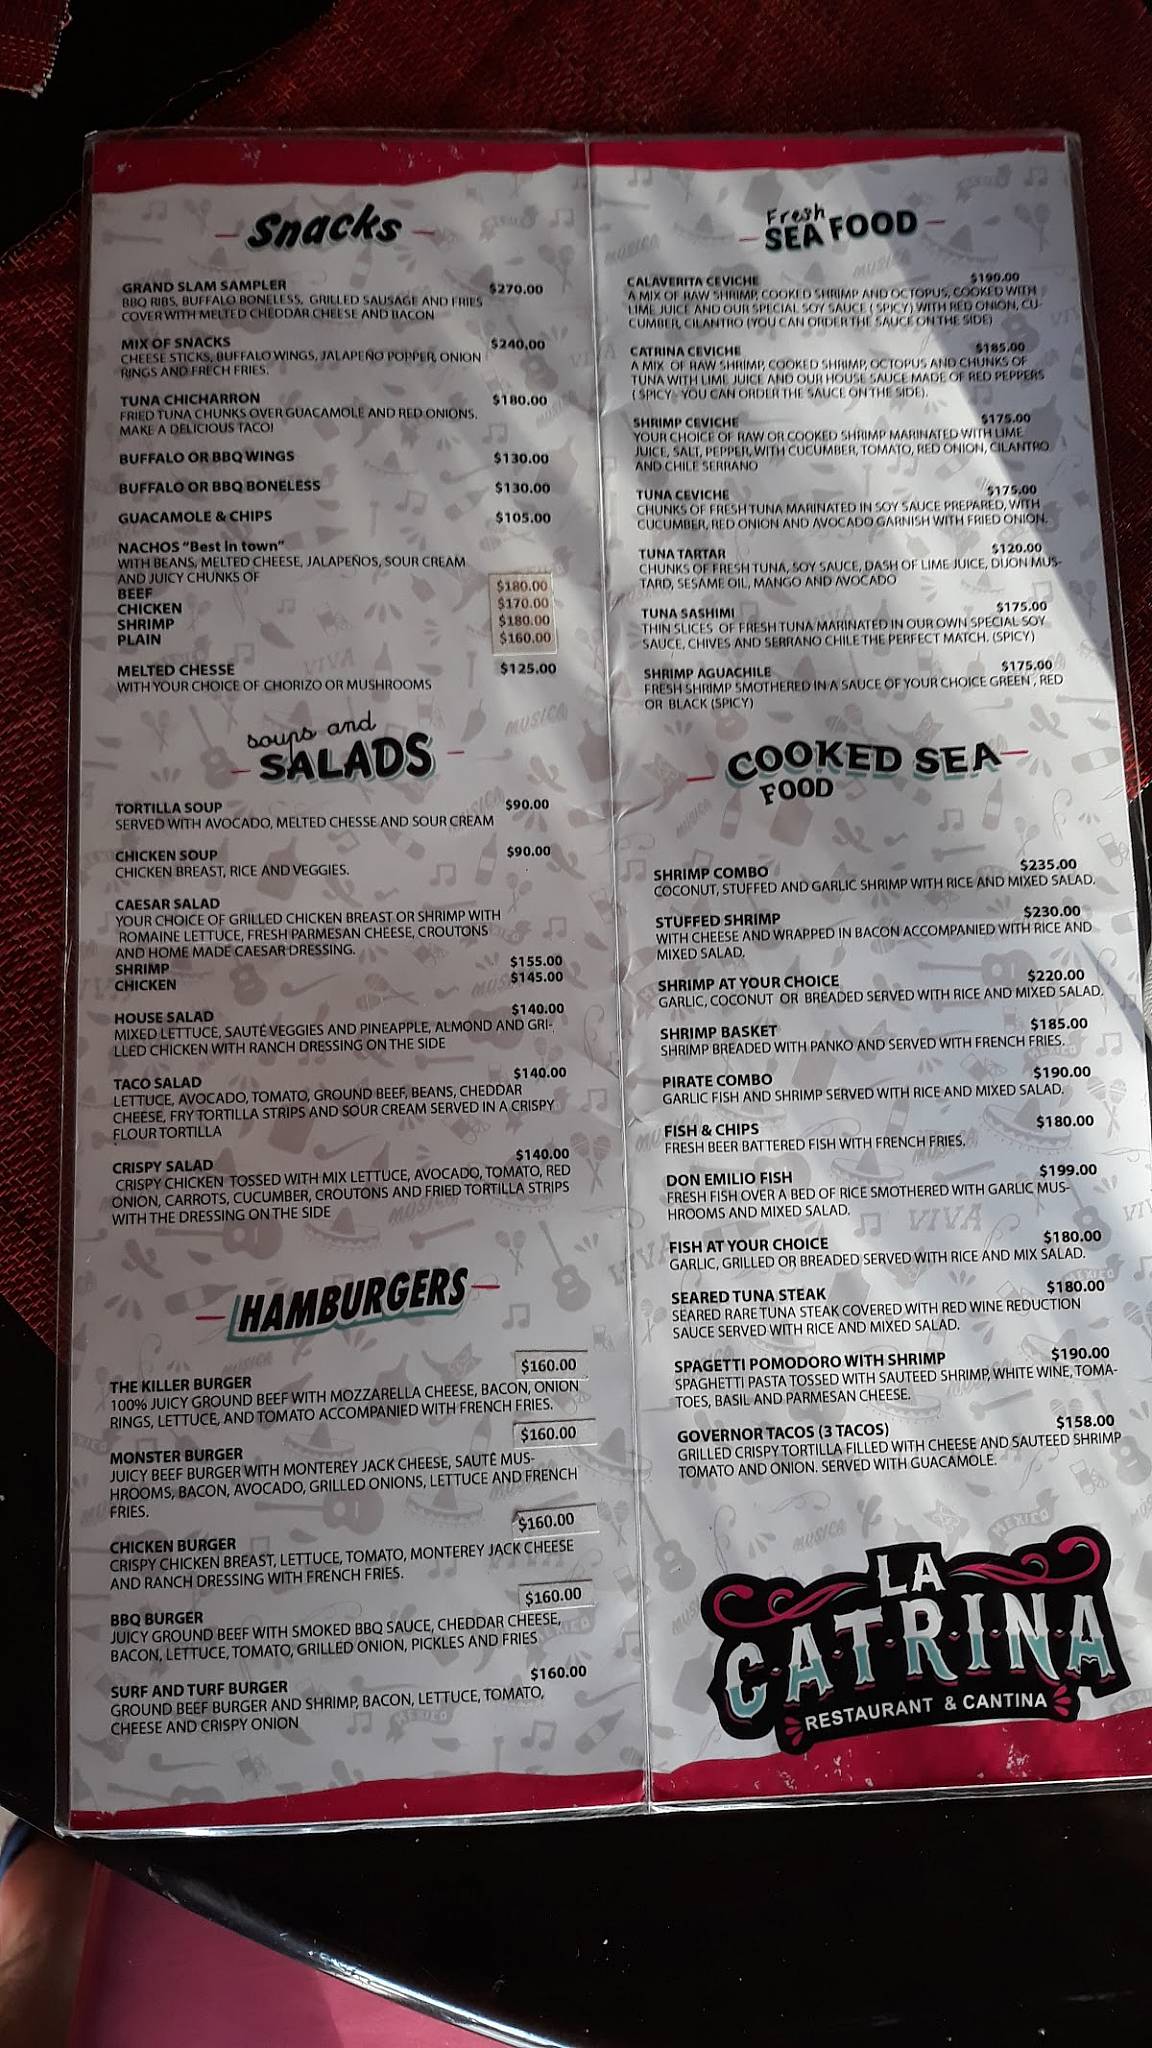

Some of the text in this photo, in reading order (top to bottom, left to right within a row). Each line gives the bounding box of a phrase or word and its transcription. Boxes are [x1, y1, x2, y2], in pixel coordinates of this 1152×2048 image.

[766, 202, 825, 226] Fresh
[247, 203, 403, 249] Snacks
[765, 209, 918, 251] SEA FOOD
[121, 279, 287, 294] GRAND SLAM SAMPLER
[489, 282, 544, 295] $270.00
[626, 275, 759, 288] CALAVERITA CEVICHE
[122, 294, 483, 309] BBQ RIBS, BUFFALO BONELESS, GRILLED SAUSAGE AND FRIES
[121, 335, 231, 351] MIX OF SNACKS
[975, 341, 1026, 354] $185.00
[630, 345, 741, 357] CATRINA CEVICHE
[120, 392, 260, 407] TUNA CHICHARRON
[492, 394, 548, 406] $180.00
[633, 416, 739, 429] SHRIMP CEVICHE
[981, 412, 1031, 426] $175.00
[119, 450, 295, 466] BUFFALO OR BBQ WINGS
[493, 451, 549, 465] $130.00
[118, 510, 273, 525] GUACAMOLE & CHIPS
[495, 511, 551, 524] $105.00
[118, 541, 180, 555] NACHOS
[640, 548, 726, 560] TUNA TARTAR
[991, 542, 1043, 555] $120.00
[117, 555, 466, 570] WITH BEANS, MELTED CHEESE, JALAPEÑOS, SOUR CREAM
[117, 587, 153, 600] BEEF
[496, 579, 548, 594] $180.00
[117, 602, 183, 616] CHICKEN
[497, 596, 550, 611] $170.00
[996, 600, 1048, 614] $175.00
[498, 613, 551, 628] $180.00
[641, 607, 735, 620] TUNA SASHIMI
[117, 618, 175, 631] SHRIMP
[117, 633, 162, 646] PLAIN
[499, 631, 552, 646] $160.00
[117, 663, 235, 678] MELTED CHESSE
[500, 661, 557, 676] $125.00
[247, 710, 377, 766] soups and
[259, 732, 434, 781] SALADS
[727, 740, 1003, 785] COOKED SEA
[759, 777, 834, 806] FOOD
[114, 801, 223, 815] TORTILLA SOUP
[505, 798, 550, 812] $90.00
[115, 814, 494, 831] SERVED WITH AVOCADO, MELTED CHESSE AND SOUR CREAM
[1020, 858, 1077, 872] $235.00
[653, 865, 769, 882] SHRIMP COMBO
[115, 897, 220, 911] CAESAR SALAD
[1023, 905, 1081, 919] $230.00
[655, 912, 781, 929] STUFFED SHRIMP
[114, 1010, 214, 1025] HOUSE SALAD
[511, 1003, 565, 1017] $140.00
[1033, 1065, 1091, 1080] $190.00
[662, 1073, 773, 1089] PIRATE COMBO
[1036, 1114, 1094, 1129] $180.00
[664, 1122, 760, 1138] FISH & CHIPS
[665, 1134, 966, 1154] FRESH BEER BATTERED FISH WITH FRENCH FRIES.
[516, 1148, 570, 1162] $140.00
[112, 1159, 214, 1175] CRISPY SALAD
[1039, 1163, 1097, 1179] $199.00
[666, 1171, 793, 1187] DON EMILIO FISH
[908, 1202, 982, 1232] VIVA
[1046, 1279, 1105, 1295] $180.00
[237, 1266, 469, 1333] HAMBURGERS
[671, 1287, 827, 1305] SEARED TUNA STEAK
[521, 1358, 577, 1374] $160.00
[109, 1376, 252, 1394] THE KILLER BURGER
[1056, 1414, 1115, 1430] $158.00
[520, 1425, 577, 1442] $160.00
[677, 1422, 889, 1443] GOVERNOR TACOS (3 TACOS)
[109, 1447, 243, 1465] MONSTER BURGER
[877, 1552, 946, 1598] LA
[525, 1587, 582, 1605] $160.00
[110, 1611, 204, 1627] BBQ BURGER
[725, 1592, 1117, 1720] CATRINA
[530, 1665, 587, 1681] $160.00
[110, 1680, 288, 1699] SURF AND TURF BURGER
[804, 1692, 1048, 1732] RESTAURANT & CANTINA
[110, 1716, 299, 1736] CHEESE AND CRISPY ONION
